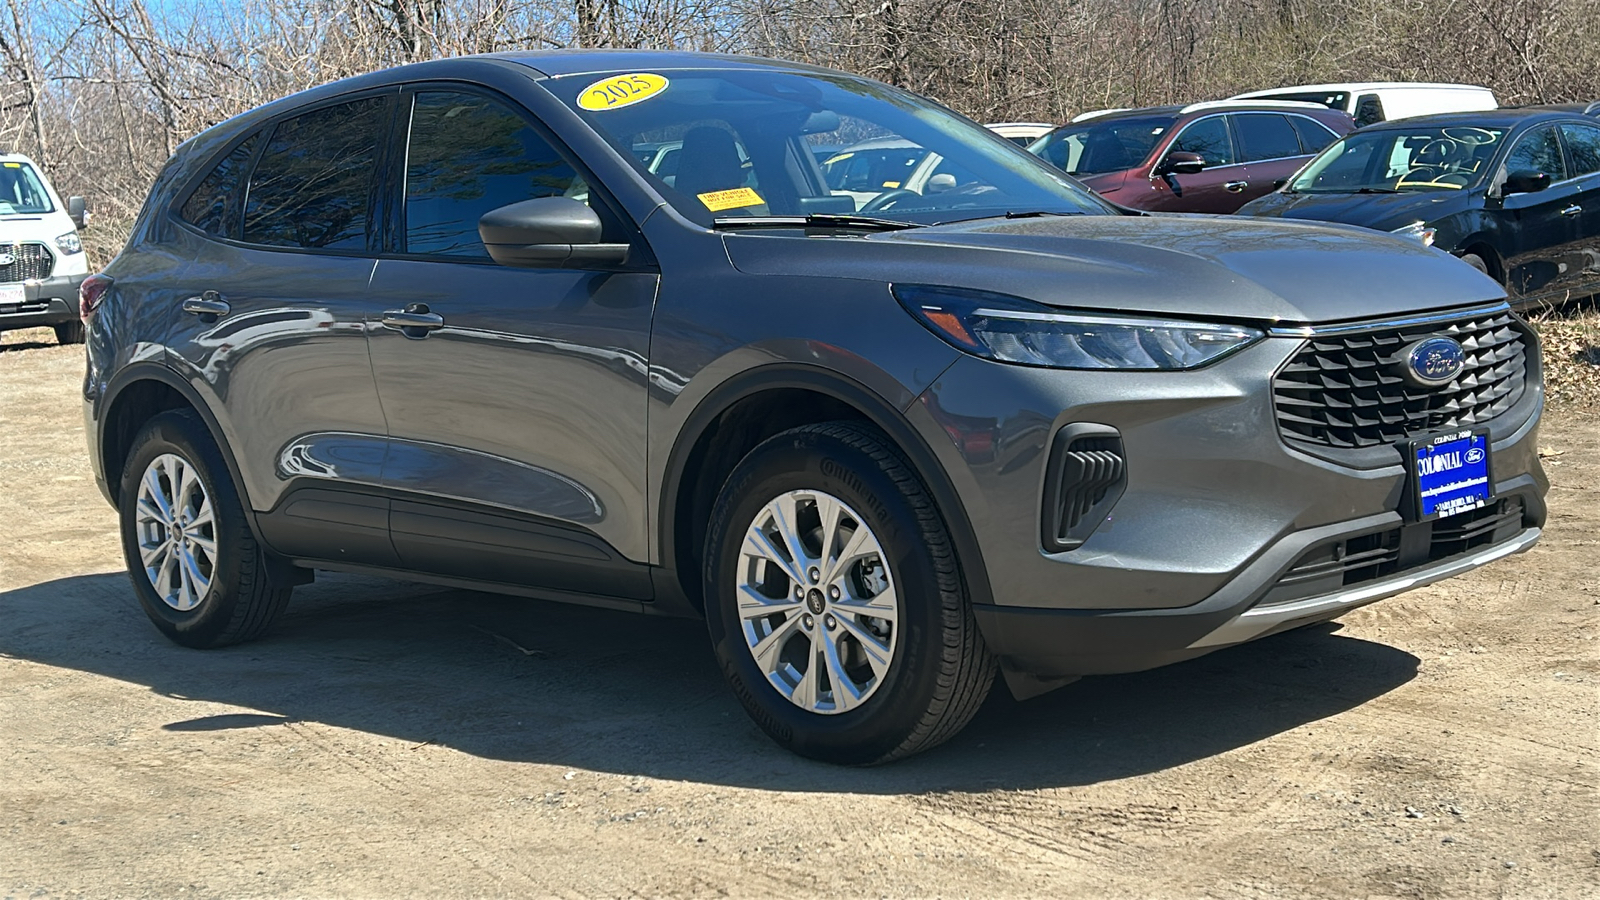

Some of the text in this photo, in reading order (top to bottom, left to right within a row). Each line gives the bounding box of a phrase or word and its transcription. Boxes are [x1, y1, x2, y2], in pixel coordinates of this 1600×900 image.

[593, 76, 651, 105] 2025
[1426, 349, 1457, 374] Ford
[1434, 433, 1458, 444] COLONIAL
[1417, 451, 1463, 477] COLONIAL
